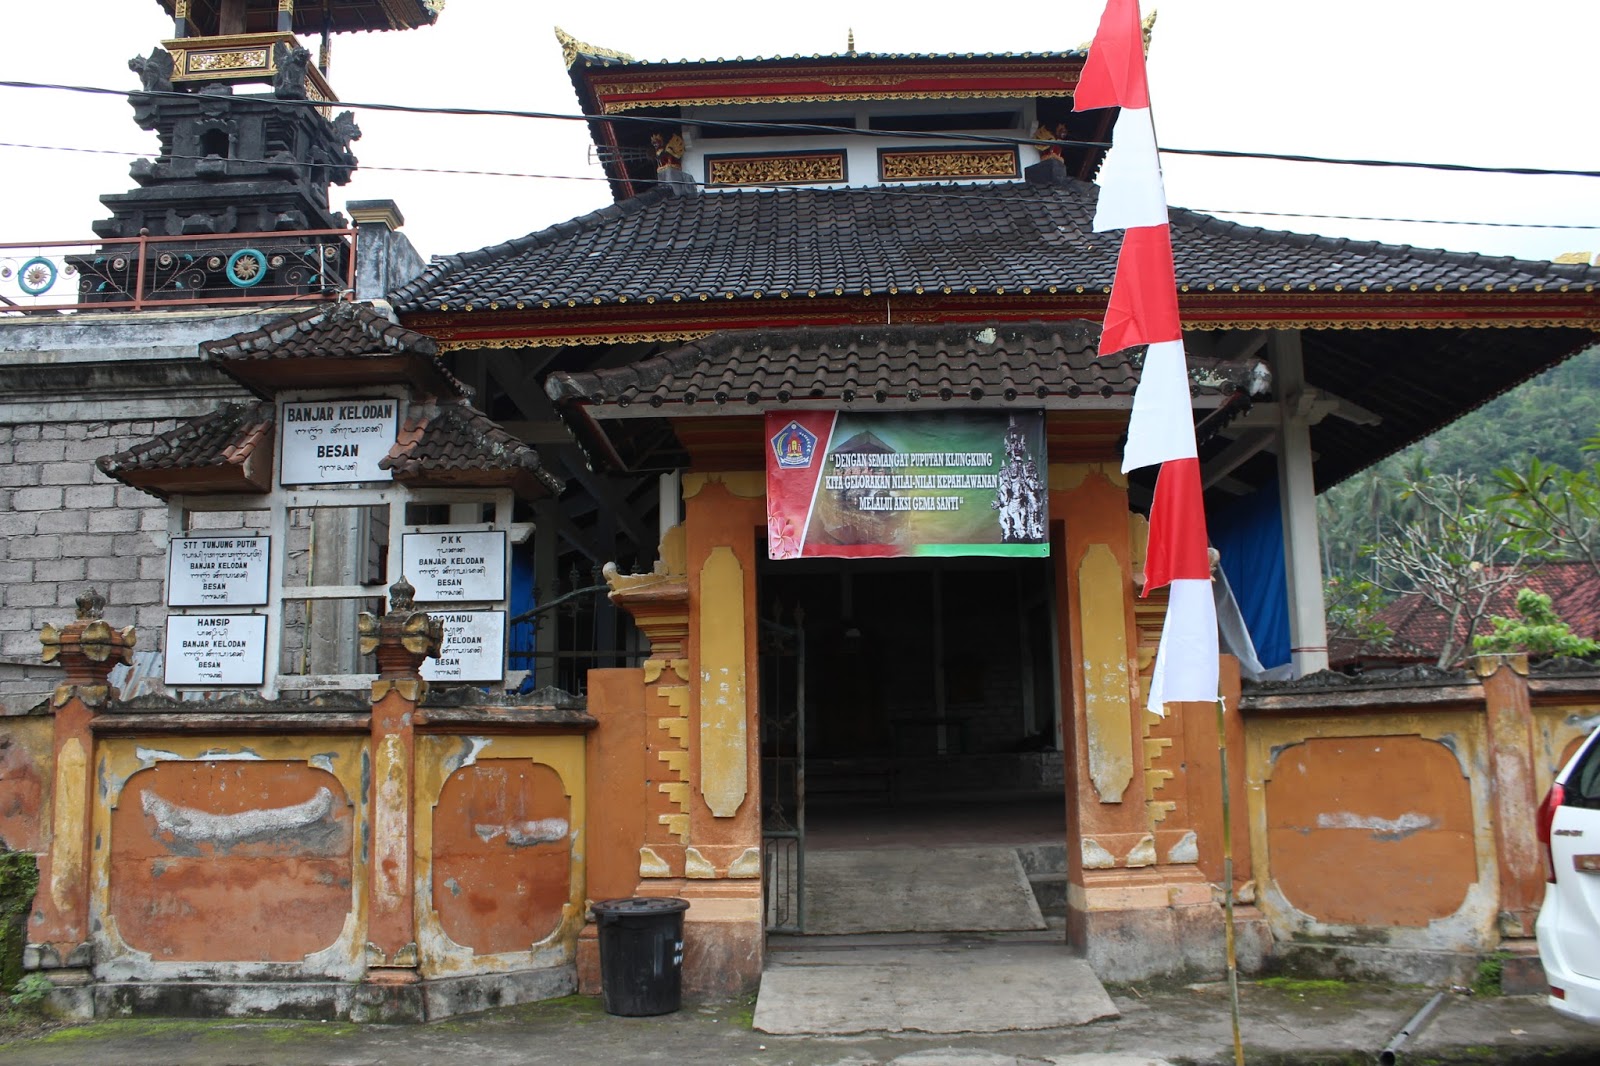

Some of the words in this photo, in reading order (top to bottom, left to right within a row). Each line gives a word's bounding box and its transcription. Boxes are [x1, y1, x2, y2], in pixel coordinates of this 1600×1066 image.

[287, 407, 334, 422] BANJAR
[339, 405, 392, 420] KELODAN
[317, 445, 359, 458] BESAN
[835, 453, 867, 467] DENGAN
[868, 453, 910, 467] SEMANGAT
[910, 453, 944, 467] PUPUTAN
[945, 453, 993, 467] KLUNGKUNG
[825, 475, 844, 489] KITA
[844, 475, 890, 489] GELORAKAN
[891, 475, 936, 488] NILAI-NILAI
[937, 474, 998, 488] KEPAHLAWANAN
[859, 497, 893, 510] MELALUI
[894, 497, 911, 510] AKSI
[912, 497, 936, 510] GEMA
[936, 497, 959, 510] SANTI
[183, 541, 198, 549] STT
[202, 541, 233, 549] TUNJUNG
[236, 540, 257, 548] PUTIH
[218, 562, 248, 570] KELODAN
[450, 557, 485, 565] KELODAN
[197, 618, 230, 627] HANSIP
[447, 636, 482, 644] KELODAN
